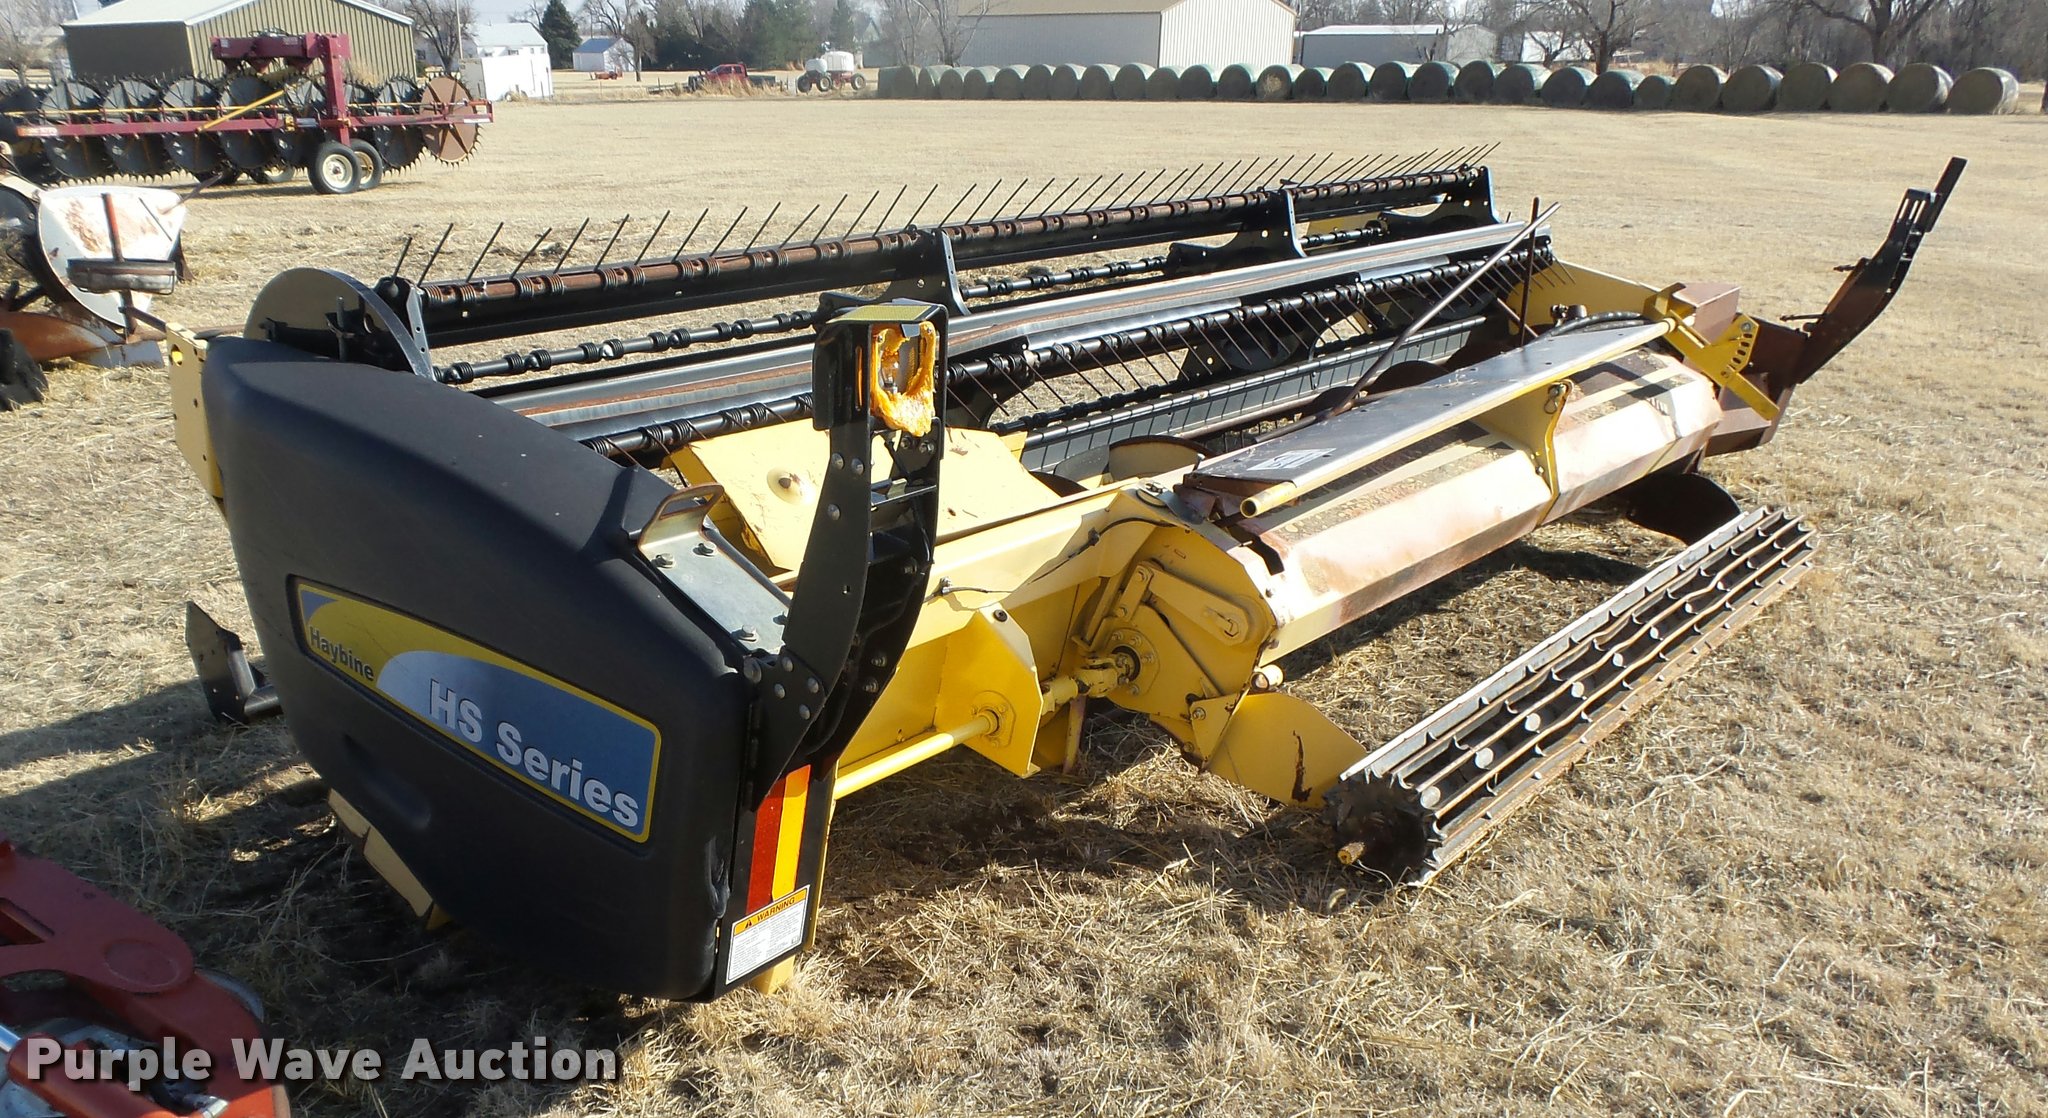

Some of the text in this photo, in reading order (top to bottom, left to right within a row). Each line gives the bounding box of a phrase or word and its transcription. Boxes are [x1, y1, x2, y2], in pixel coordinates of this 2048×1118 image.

[308, 625, 375, 682] Haybine
[429, 679, 640, 828] HS Series
[757, 897, 795, 923] WARNING
